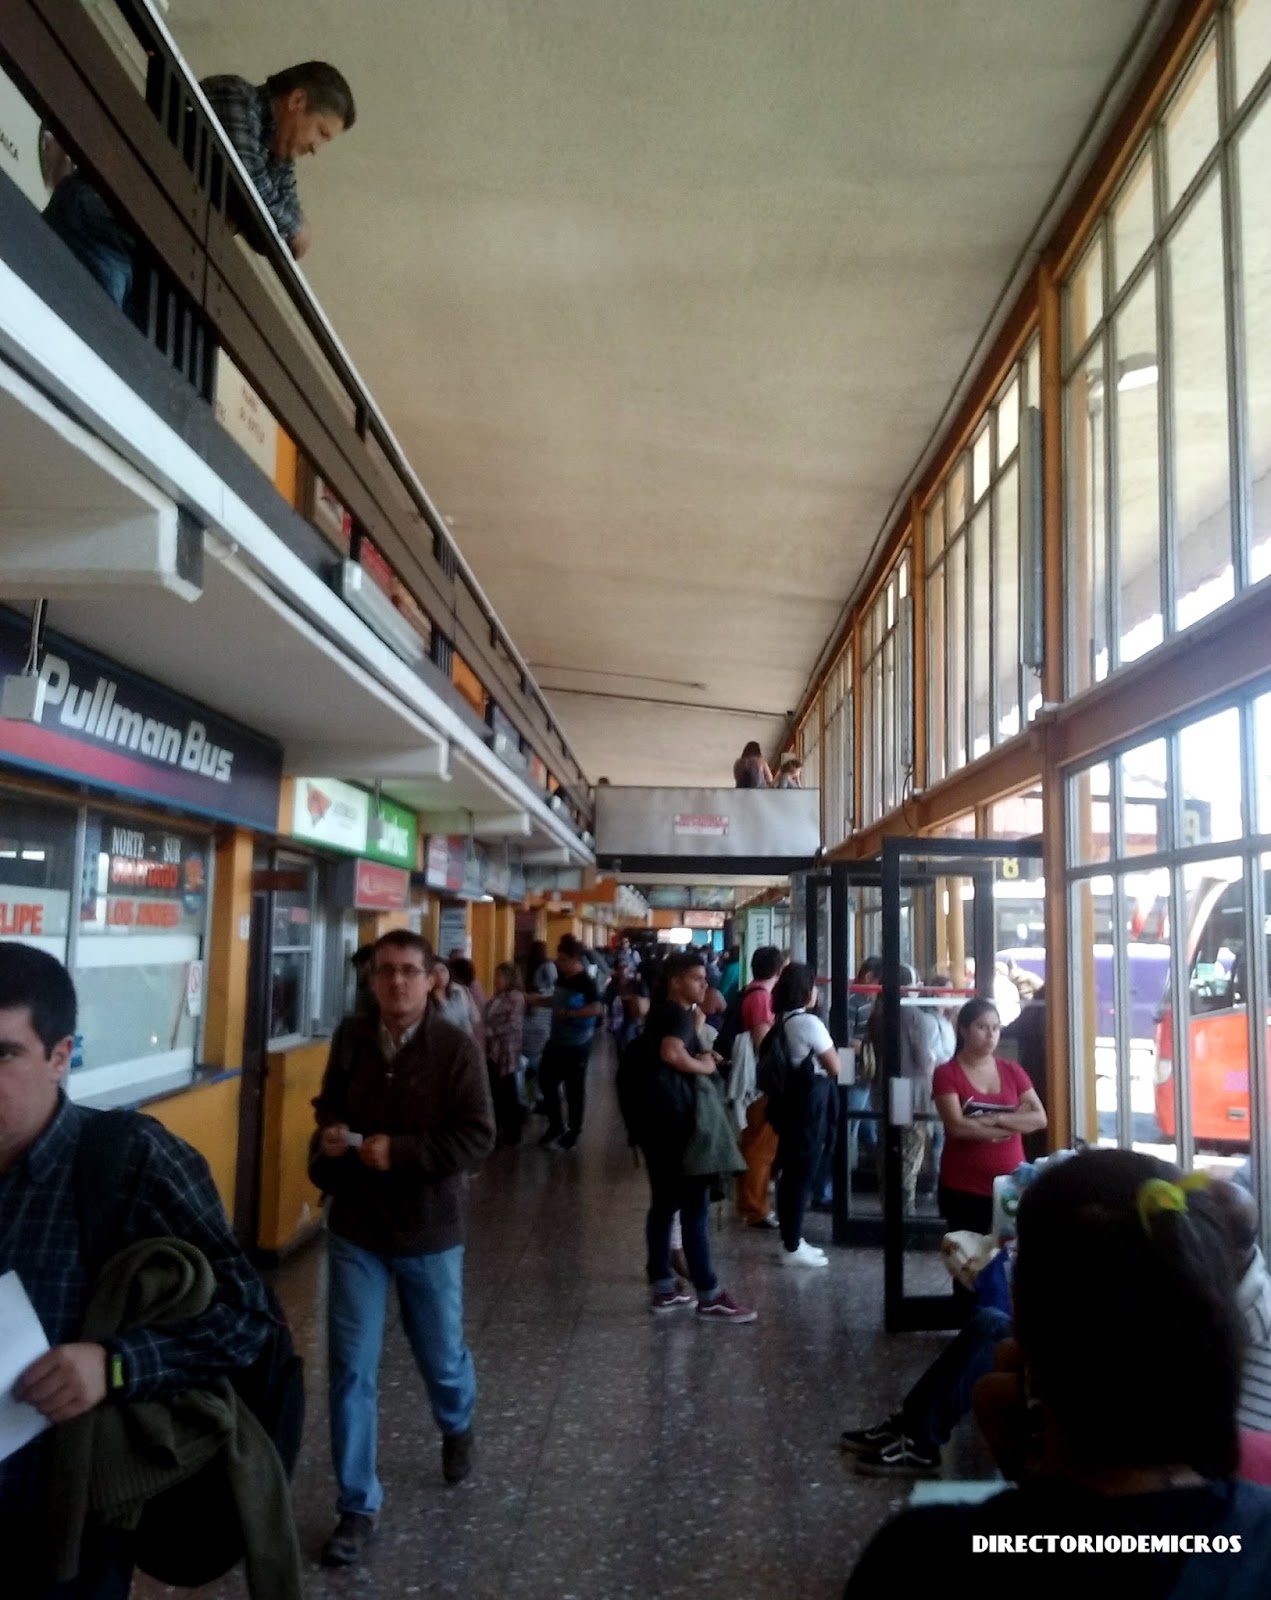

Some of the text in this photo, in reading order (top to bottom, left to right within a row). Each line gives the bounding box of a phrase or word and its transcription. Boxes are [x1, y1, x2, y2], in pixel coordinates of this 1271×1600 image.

[34, 653, 234, 784] Pullman Bus
[111, 826, 181, 864] NORTE SUR
[0, 902, 43, 935] LIPE
